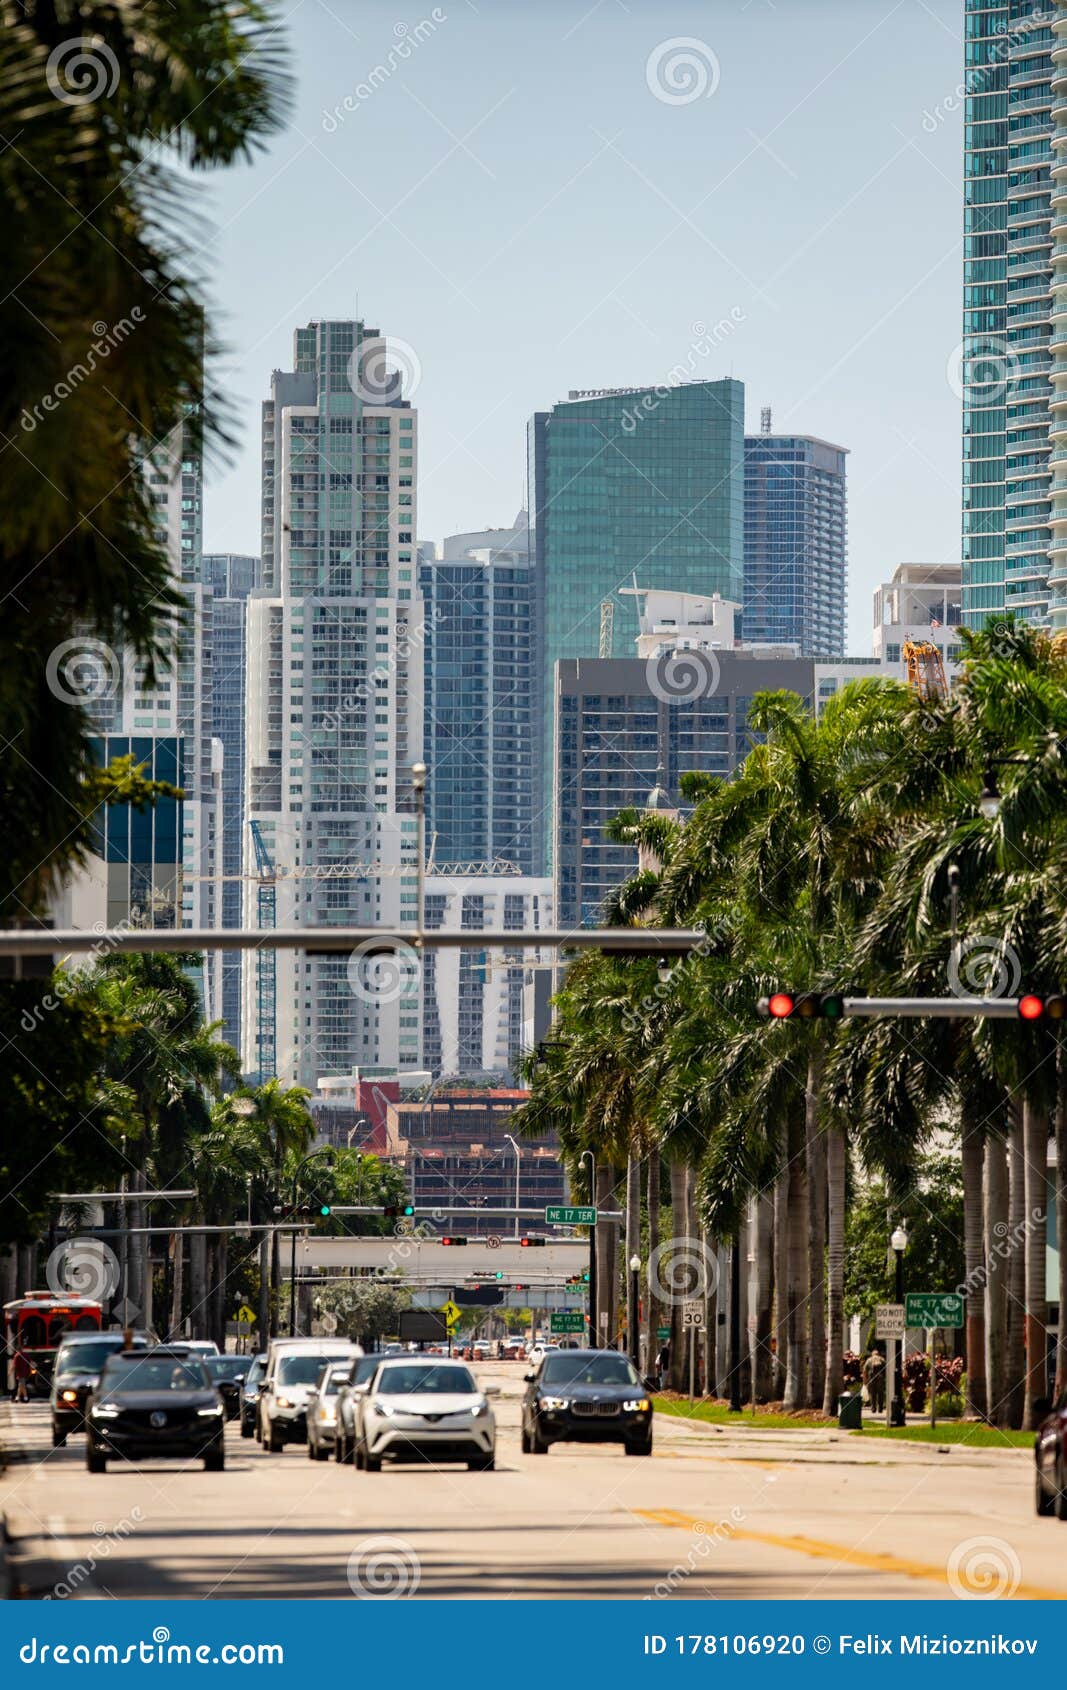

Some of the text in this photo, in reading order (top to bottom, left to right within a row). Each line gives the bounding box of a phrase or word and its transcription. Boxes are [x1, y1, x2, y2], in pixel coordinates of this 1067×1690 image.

[550, 1210, 593, 1221] NE 17 TER
[909, 1299, 922, 1308] NE
[927, 1299, 937, 1308] 17
[877, 1309, 905, 1317] DO NOT
[684, 1313, 702, 1324] 30
[877, 1320, 904, 1329] BLOCK
